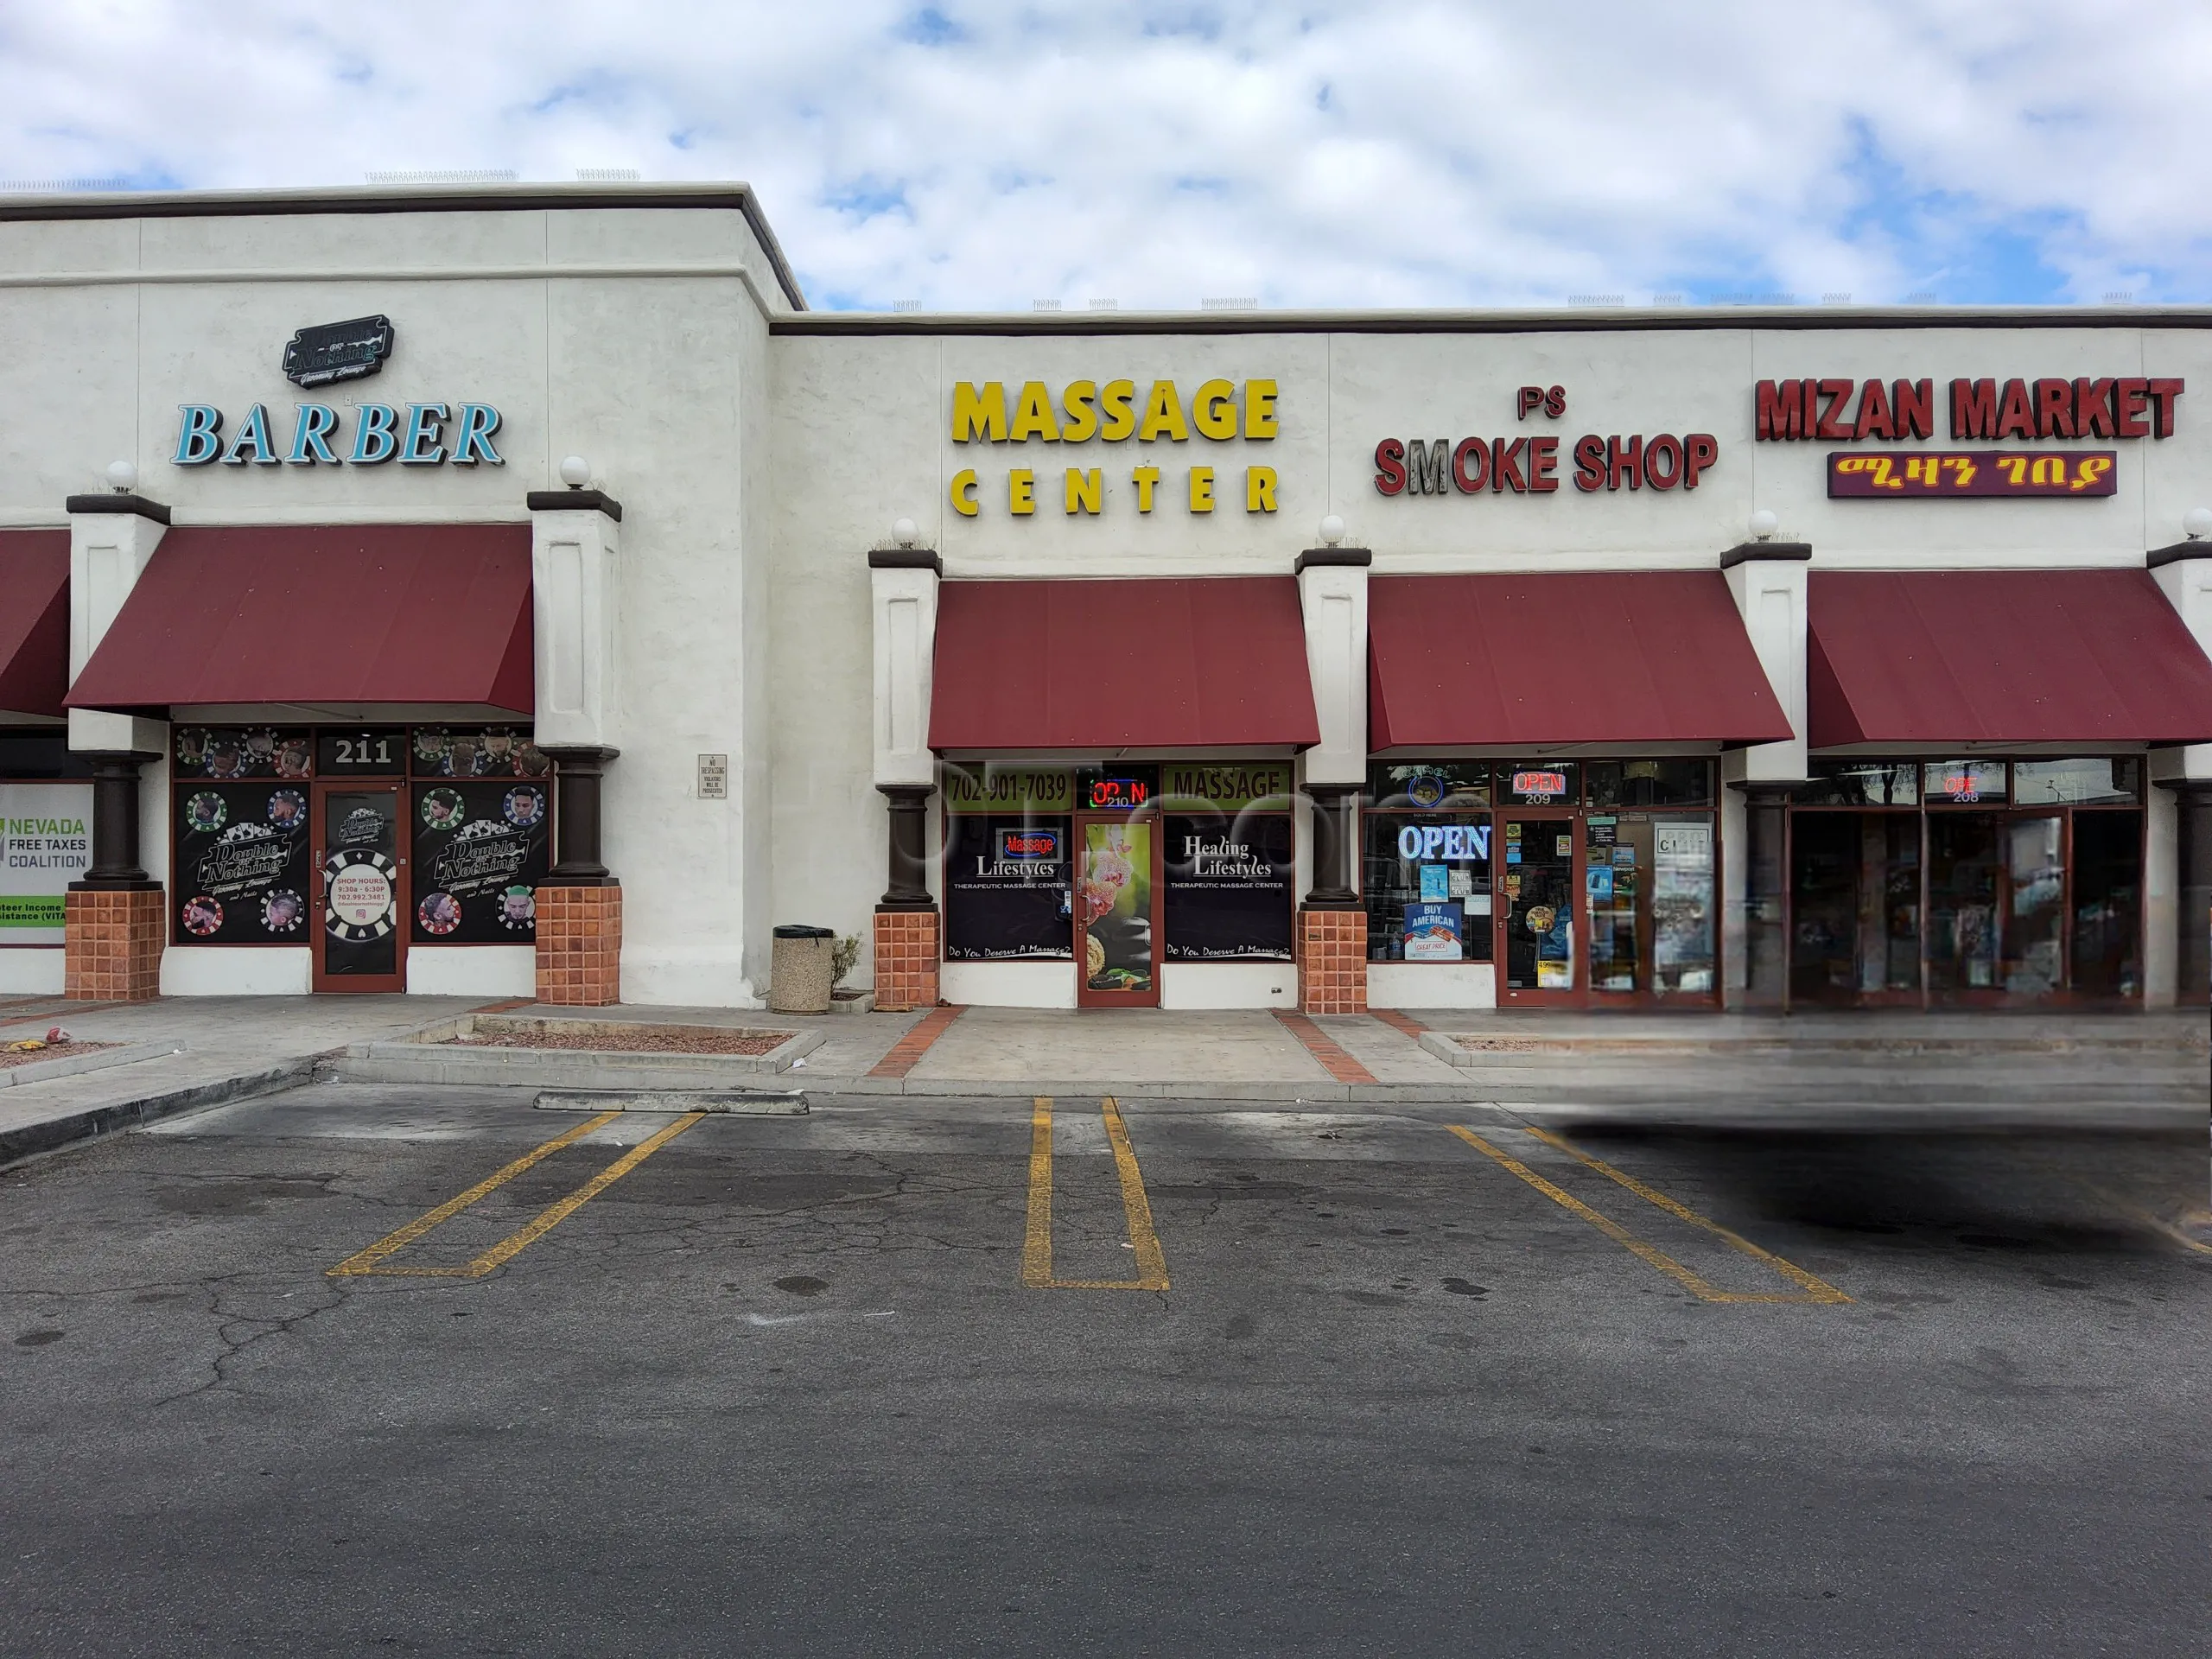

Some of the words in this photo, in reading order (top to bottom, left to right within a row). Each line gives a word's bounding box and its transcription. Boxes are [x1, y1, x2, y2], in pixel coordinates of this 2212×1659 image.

[293, 345, 378, 370] Nothing
[951, 378, 1280, 443] MASSAGE
[1516, 385, 1567, 421] PS
[1755, 378, 1934, 441] MIZAN
[1949, 377, 2185, 440] MARKET
[170, 402, 505, 467] BARBER
[1373, 435, 1560, 496] SMOKE
[1573, 433, 1719, 493] SHOP
[950, 467, 1279, 517] CENTER
[335, 740, 391, 763] 211
[951, 773, 1066, 801] 702-901-7039
[1173, 771, 1280, 800] MASSAGE
[1515, 773, 1562, 791] OPEN
[1107, 797, 1129, 807] 210
[1525, 794, 1551, 804] 209
[1954, 792, 1979, 803] 208
[10, 819, 85, 835] NEVADA
[10, 839, 41, 850] FREE
[46, 839, 86, 850] TAXES
[216, 843, 279, 861] Double
[452, 840, 517, 859] Double
[1007, 836, 1054, 854] Massage
[1184, 836, 1249, 859] Healing
[1398, 825, 1491, 860] OPEN
[10, 855, 86, 868] COALITION
[205, 860, 283, 883] Nothing
[442, 857, 520, 880] Nothing
[976, 855, 1054, 879] Lifestyles
[1193, 855, 1271, 879] Lifestyles
[25, 903, 61, 912] Income
[1424, 905, 1442, 915] BUY
[1412, 915, 1454, 928] AMERICAN
[949, 945, 961, 957] Do
[964, 947, 981, 957] You
[984, 948, 1017, 957] Deserve
[1020, 944, 1026, 953] A
[1166, 944, 1179, 955] Do
[1182, 945, 1199, 956] You
[1203, 946, 1235, 956] Deserve
[1238, 944, 1244, 954] A
